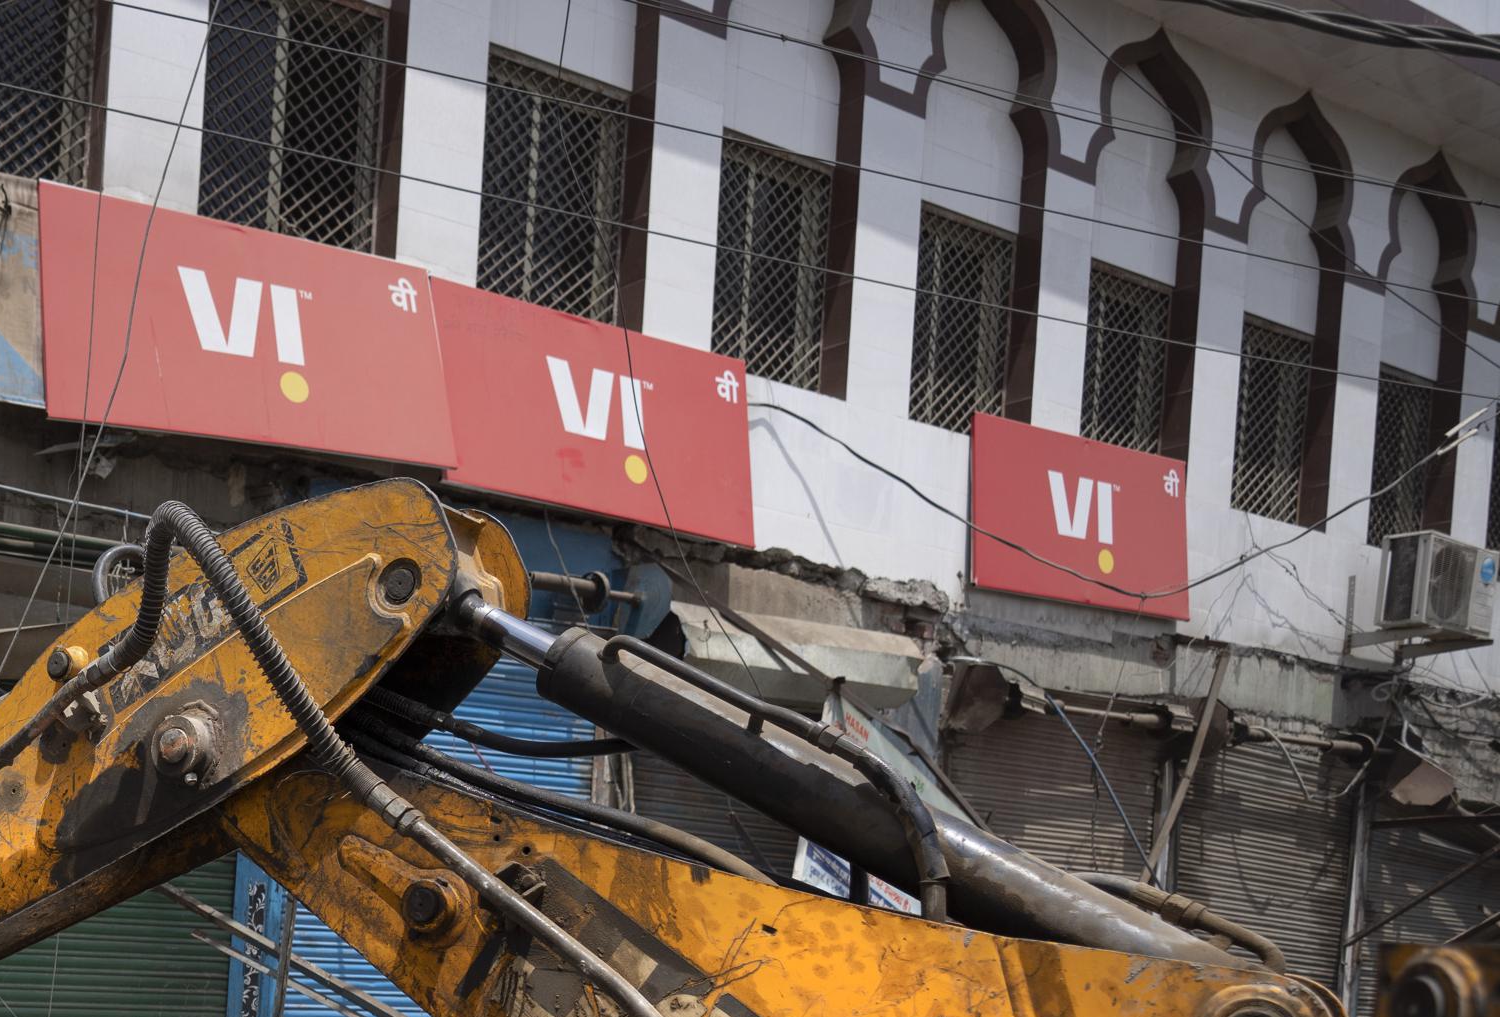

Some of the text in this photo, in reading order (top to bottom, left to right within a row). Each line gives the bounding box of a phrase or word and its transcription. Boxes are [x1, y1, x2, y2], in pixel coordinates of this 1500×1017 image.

[387, 277, 418, 314] वी
[714, 369, 739, 404] वी
[1162, 468, 1180, 498] वी
